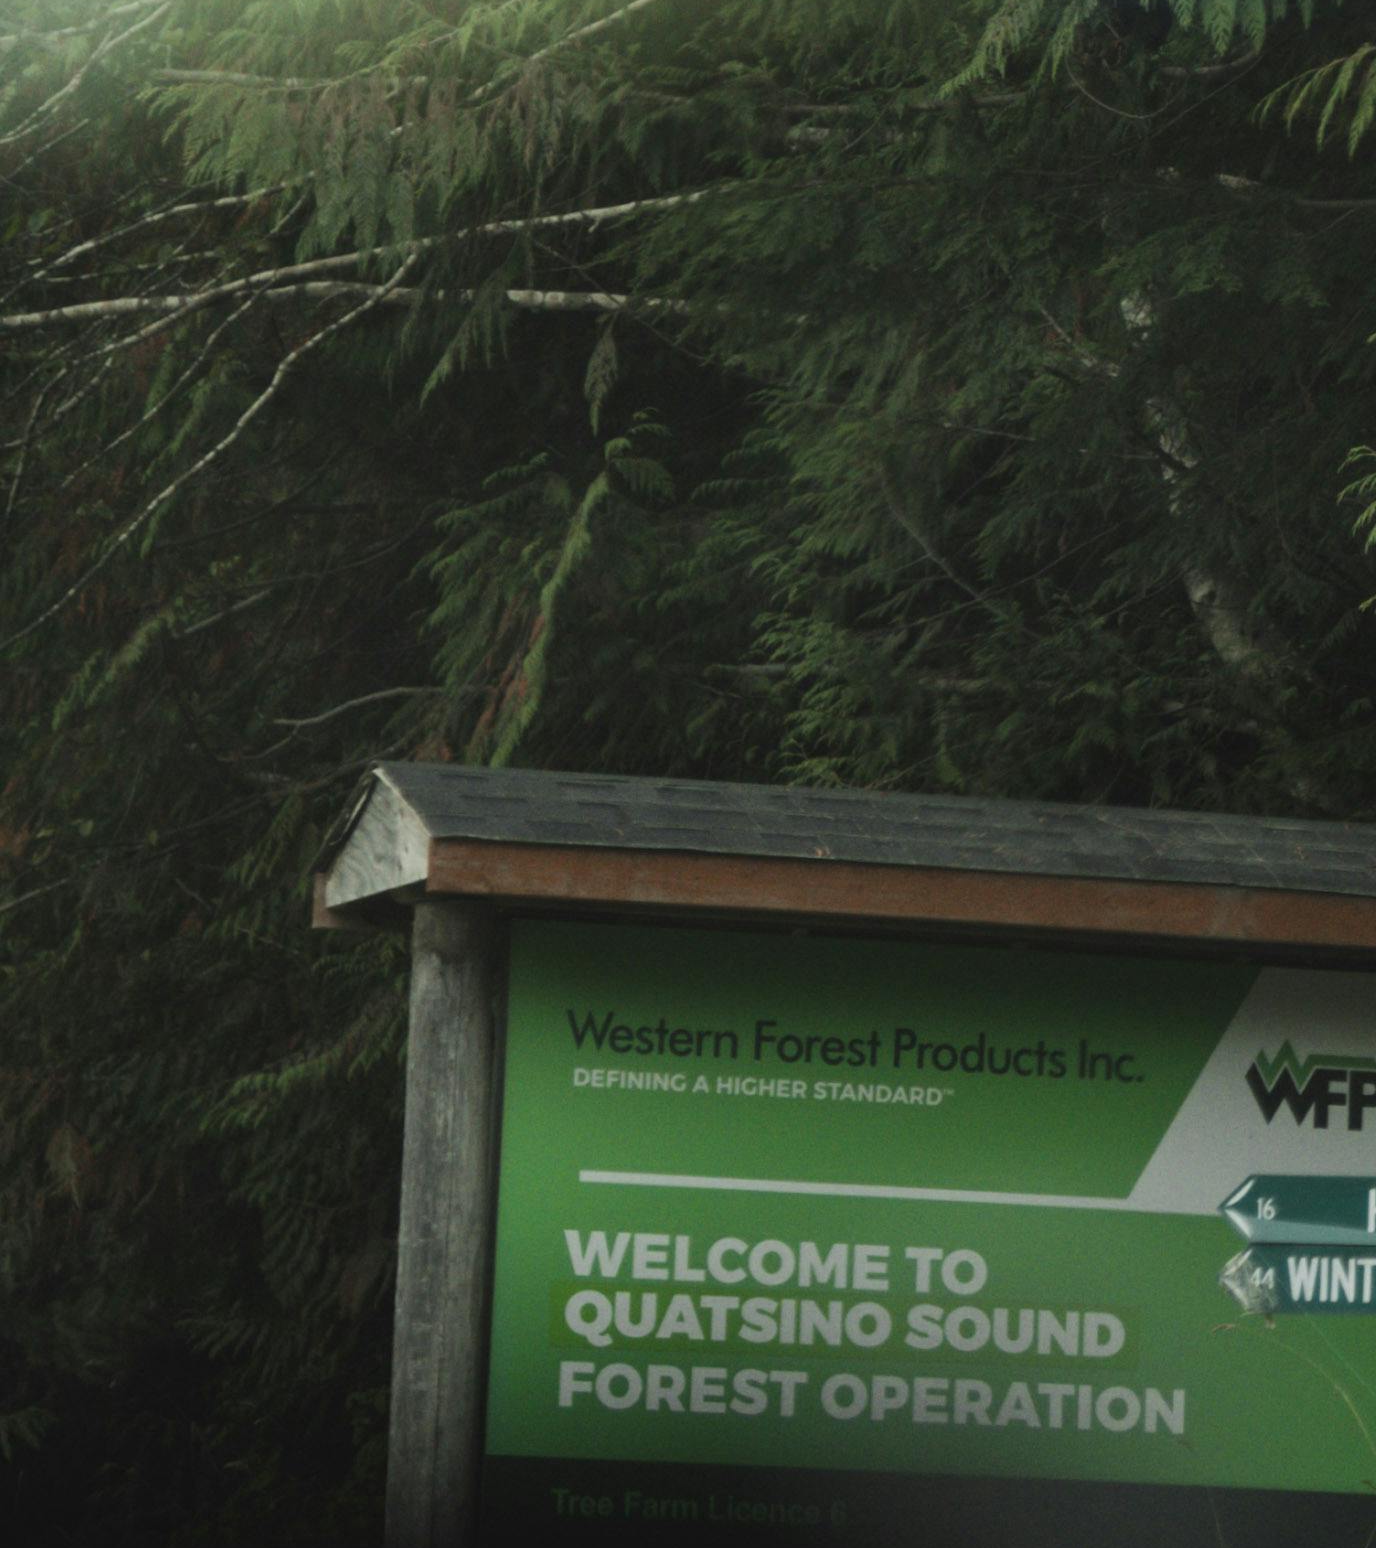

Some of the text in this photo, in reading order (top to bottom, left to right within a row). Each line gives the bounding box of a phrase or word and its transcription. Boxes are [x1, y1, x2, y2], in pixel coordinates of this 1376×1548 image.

[565, 1005, 1147, 1085] Western Forest Products Inc.
[573, 1067, 686, 1092] DEFINING
[692, 1074, 710, 1093] A
[716, 1076, 807, 1100] HIGHER
[1256, 1196, 1276, 1220] 16
[563, 1228, 989, 1297] WELCOME TO
[1250, 1267, 1275, 1289] 44
[563, 1288, 1128, 1359] QUATSINO SOUND
[557, 1358, 1189, 1436] FOREST OPERATION
[550, 1488, 615, 1518] Tree
[623, 1490, 699, 1523] Farm
[708, 1495, 822, 1528] Licence
